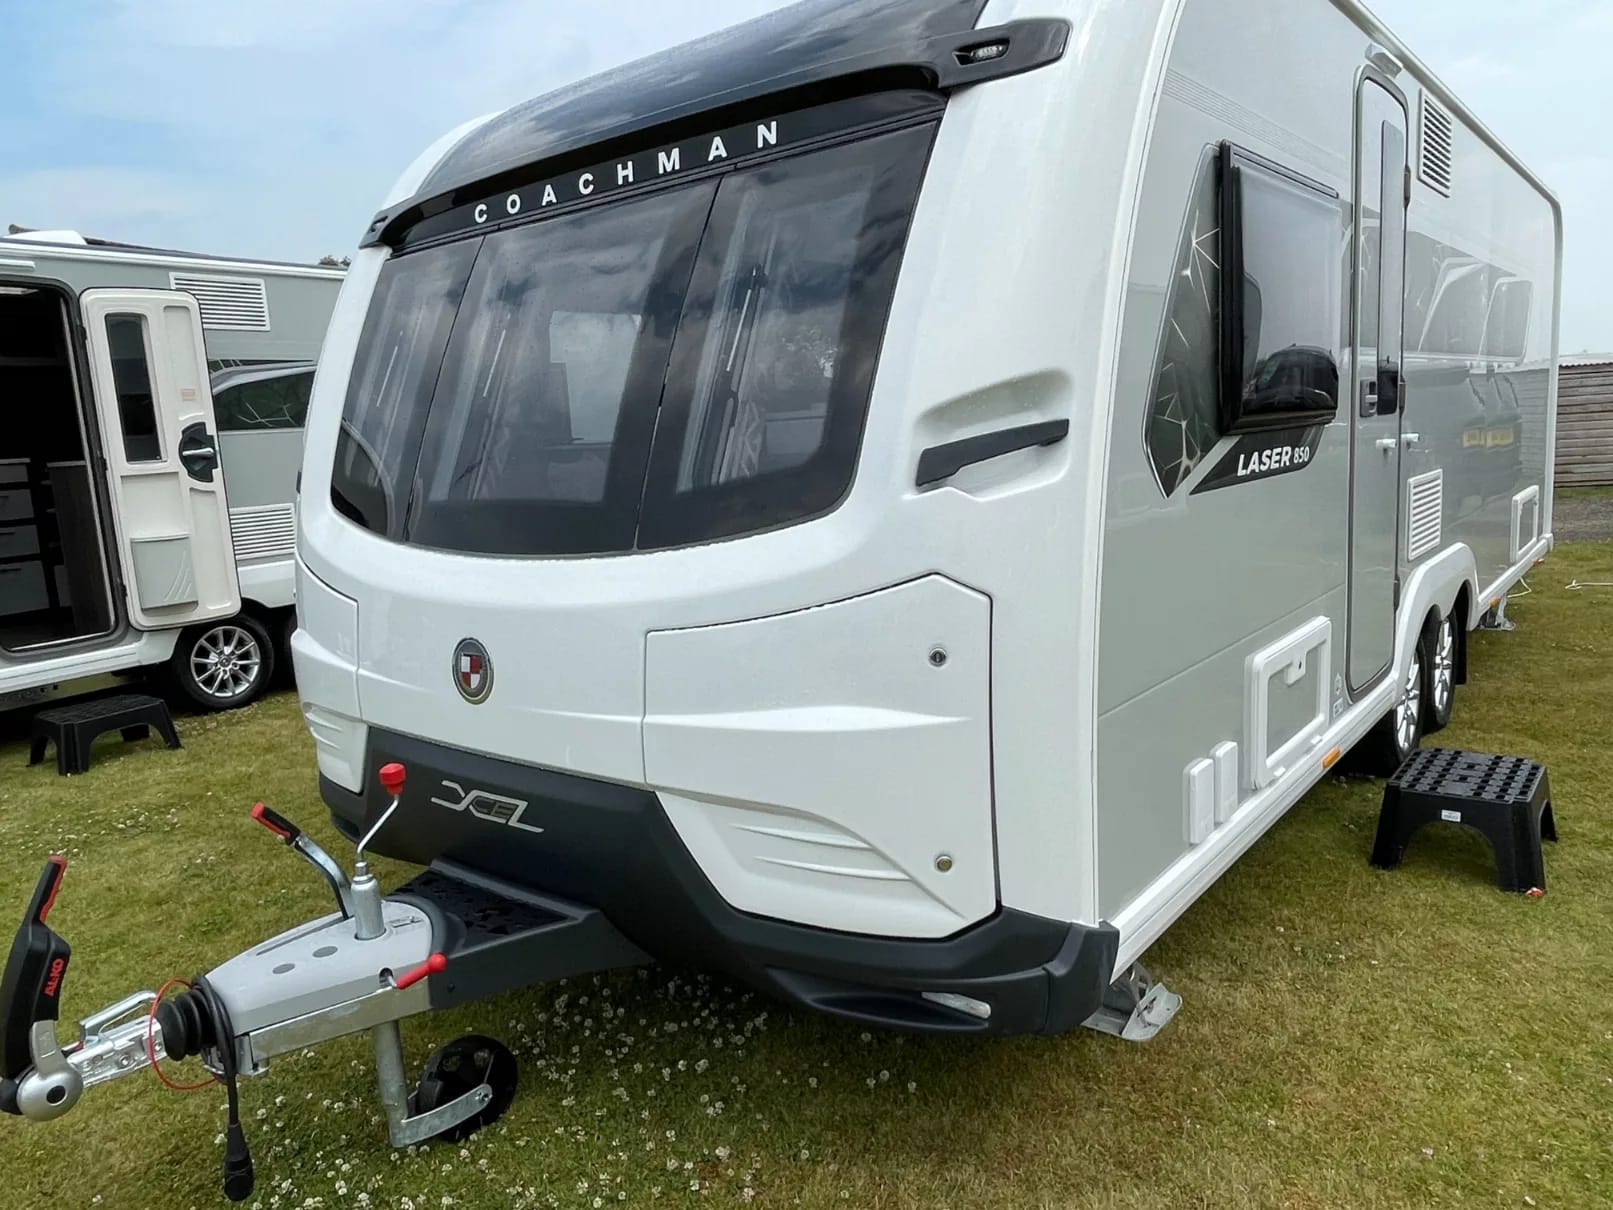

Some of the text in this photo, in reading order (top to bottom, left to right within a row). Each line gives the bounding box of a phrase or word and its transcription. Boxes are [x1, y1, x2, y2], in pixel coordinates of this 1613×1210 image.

[474, 120, 778, 224] COACHMAN
[1236, 446, 1310, 477] LASER 850
